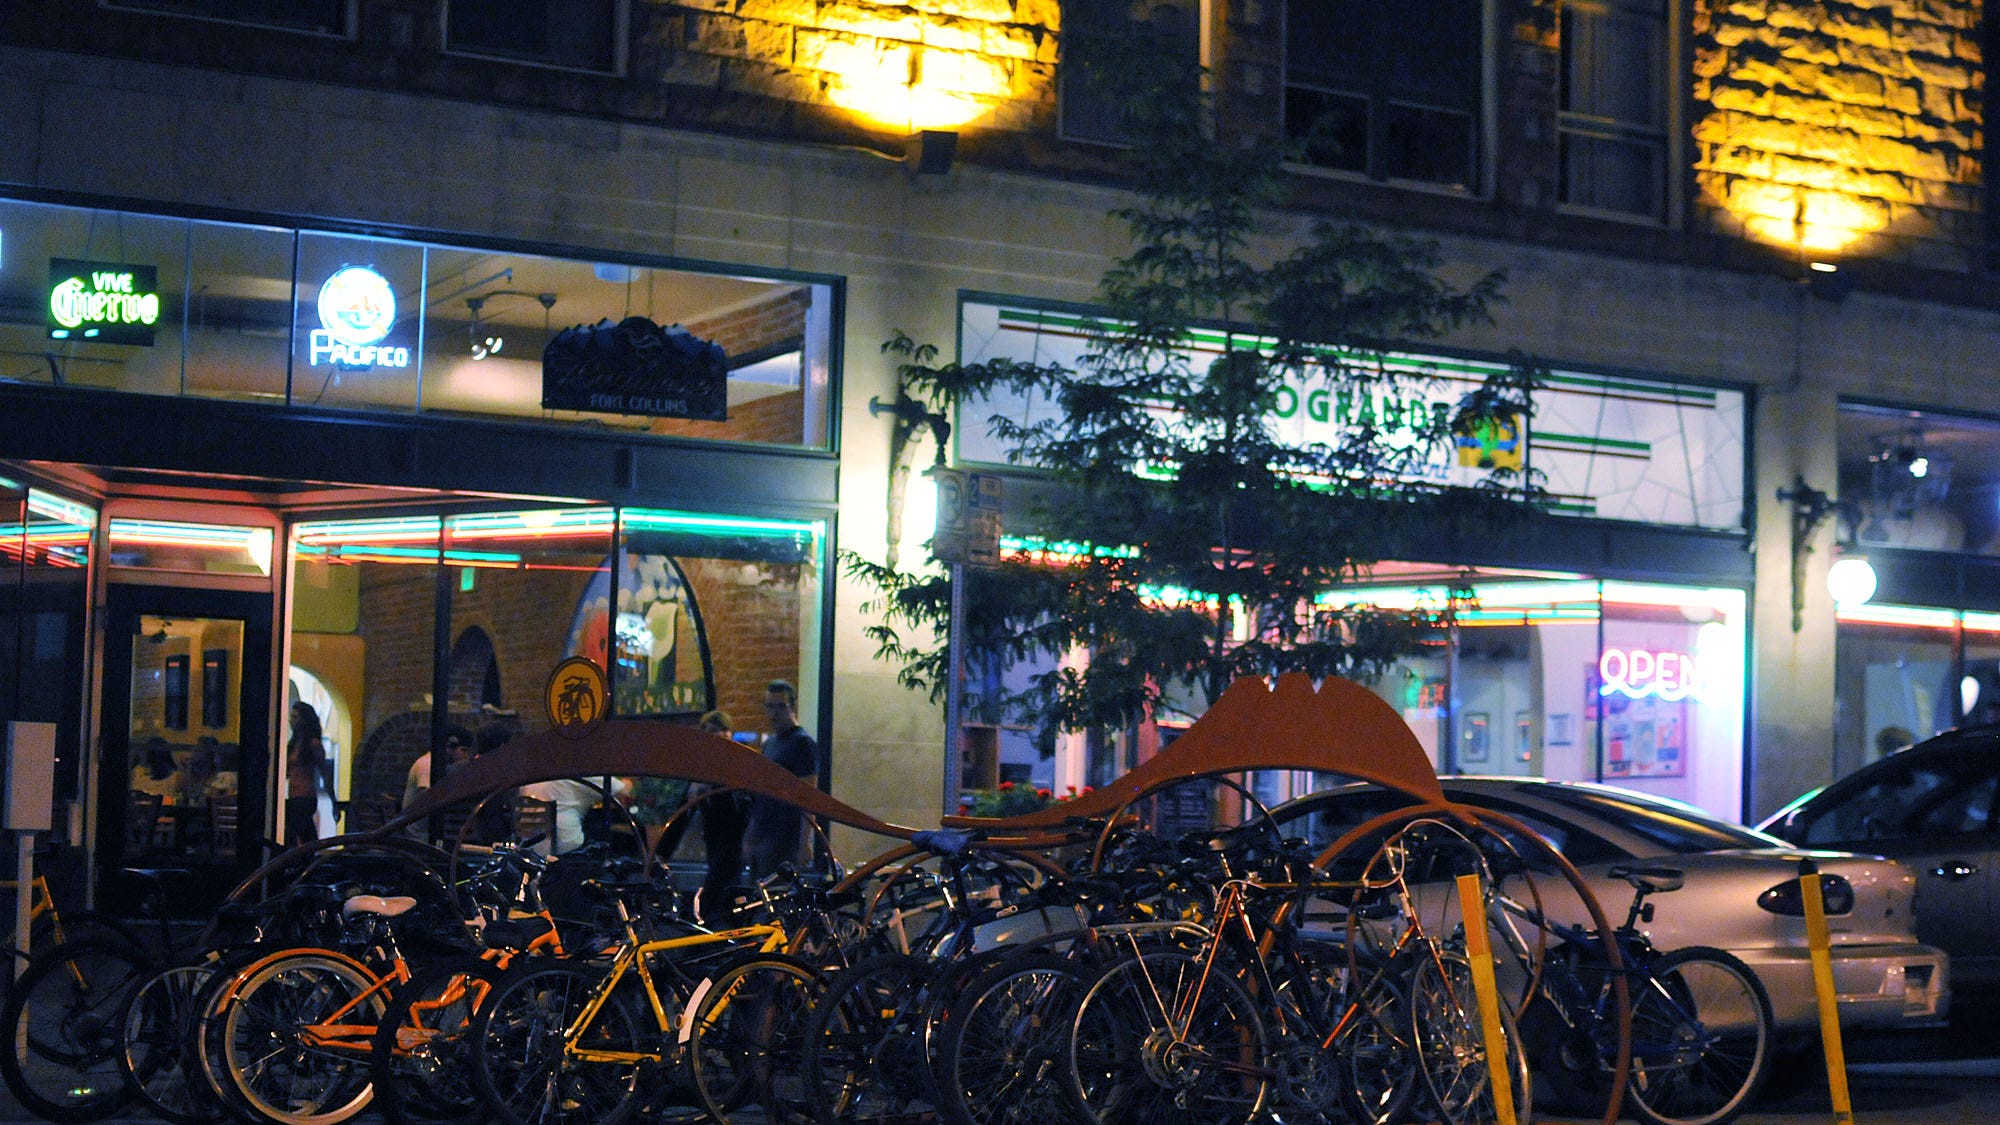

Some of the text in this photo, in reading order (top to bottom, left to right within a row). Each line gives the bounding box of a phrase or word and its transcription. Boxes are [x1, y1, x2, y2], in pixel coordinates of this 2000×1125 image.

[91, 271, 133, 293] VIVE
[590, 393, 688, 415] FORT COLLINS
[1599, 648, 1703, 690] OPEN
